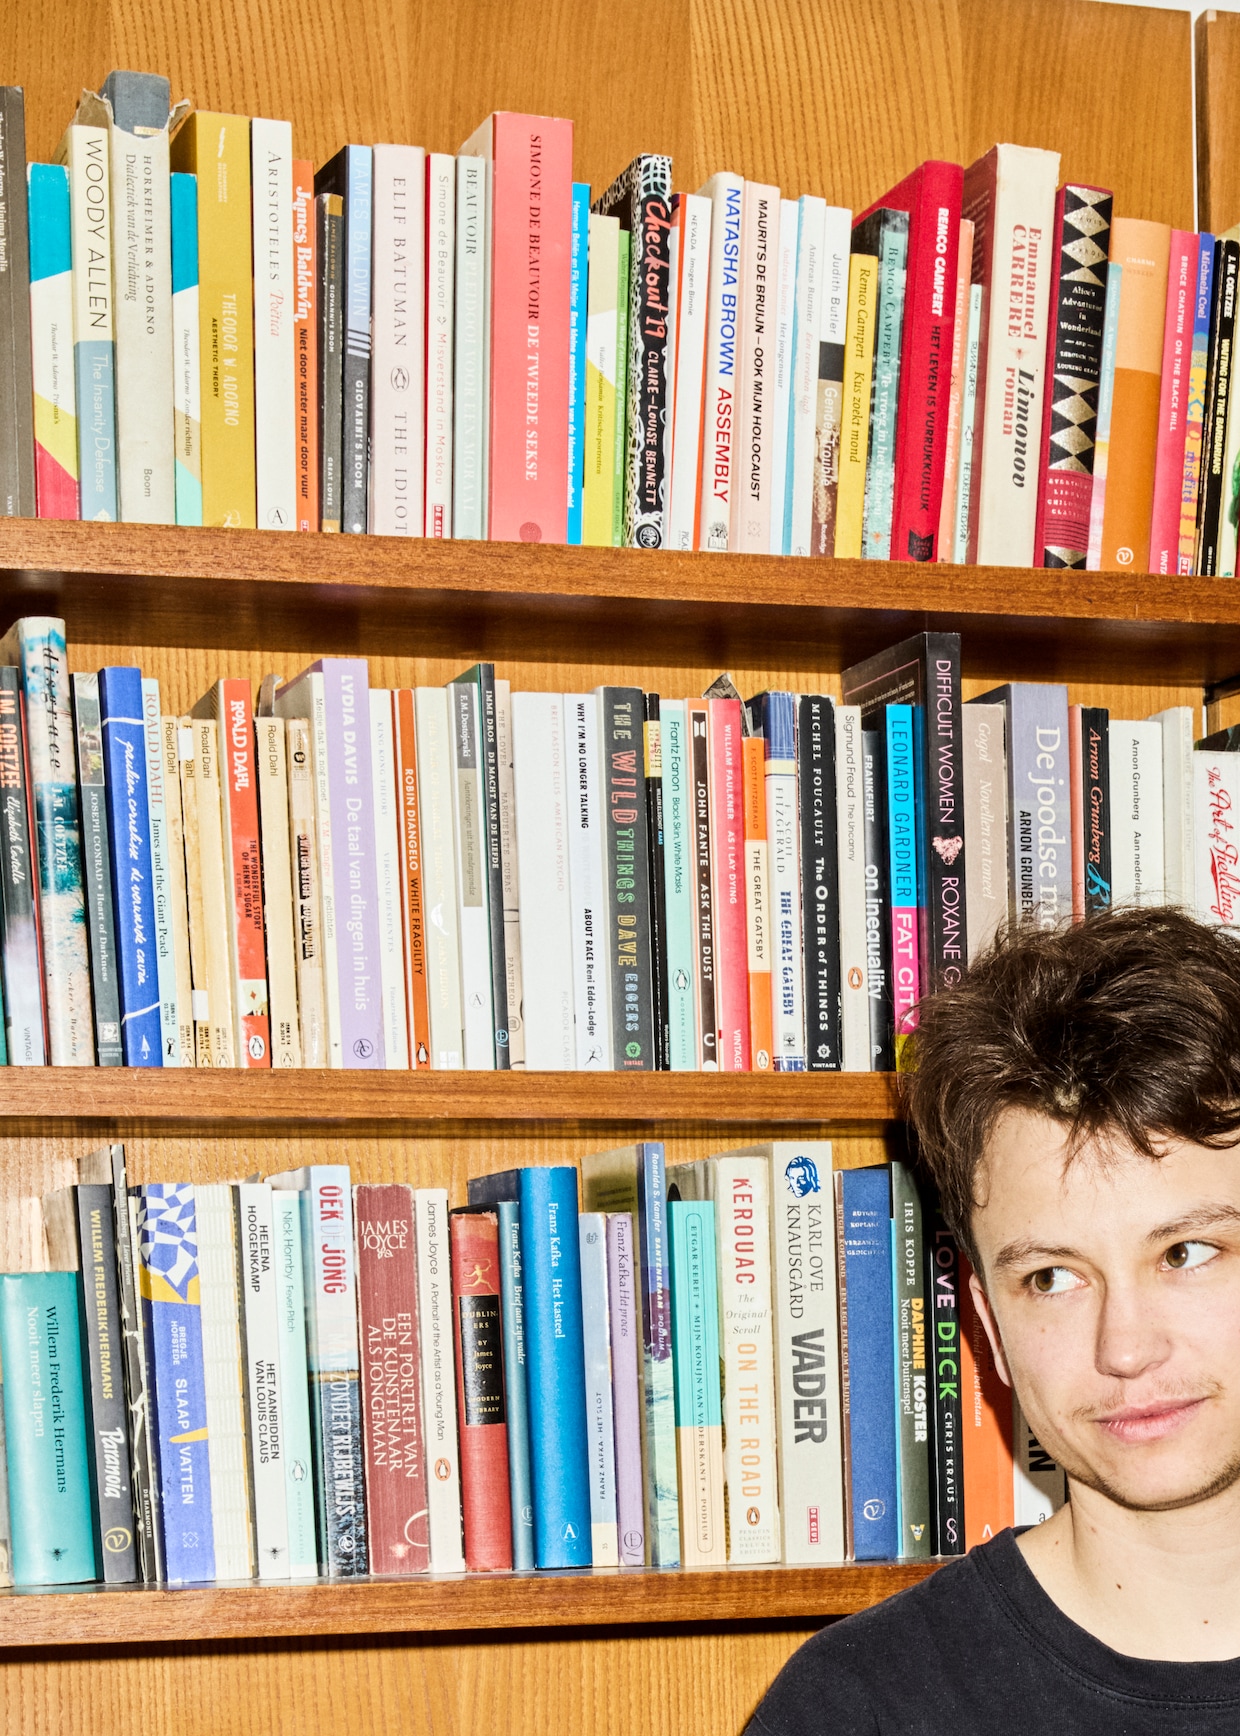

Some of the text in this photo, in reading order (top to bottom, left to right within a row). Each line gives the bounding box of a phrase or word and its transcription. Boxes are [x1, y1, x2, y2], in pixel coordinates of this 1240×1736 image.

[85, 138, 108, 329] WOODY ALLEN
[143, 155, 156, 336] HORKHEIMER & ADORNO
[268, 151, 284, 336] ARISTOTELES Poëtica
[1024, 228, 1042, 342] Emmanuel
[1180, 255, 1188, 286] BRUCE
[393, 176, 408, 535] ELIF BATUMAN THE IDIOT
[526, 134, 542, 481] SIMONE DE BEAUVOIR DE TWEEDE SEKSE
[645, 314, 665, 339] 19
[714, 188, 741, 503] NATASHA BROWN ASSEMBLY
[1175, 340, 1182, 354] ON
[1176, 290, 1186, 334] CHATWIN
[1001, 366, 1016, 436] roman
[1012, 367, 1038, 488] Limonov
[1172, 379, 1180, 408] BLACK
[644, 450, 657, 506] BENNETT
[230, 700, 249, 791] ROALD DAHL
[812, 702, 823, 847] MICHEL FOUCAULT
[864, 754, 874, 823] FRANKFURT
[340, 674, 370, 1011] LYDIA DAVIS De taal van dingen in huis
[891, 719, 912, 899] LEONARD GARDNER
[405, 768, 423, 975] ROBIN DIANGELO WHITE FRAGILITY
[611, 702, 638, 1032] THE WILD THINGS DAVE EGGERS
[752, 849, 764, 960] THE GREAT GATSBY
[865, 897, 884, 999] inequality
[360, 1219, 408, 1236] JAMES
[362, 1233, 407, 1251] JOYCE
[732, 1178, 756, 1286] KEROUAC
[808, 1204, 824, 1292] KARL OVE
[46, 1306, 66, 1493] Willem Frederik Hermans
[791, 1328, 828, 1444] VADER
[938, 1321, 957, 1401] DICK
[98, 1427, 127, 1499] Paranoia
[737, 1343, 761, 1499] ON THE ROAD
[944, 1411, 955, 1503] CHRIS KRAUS
